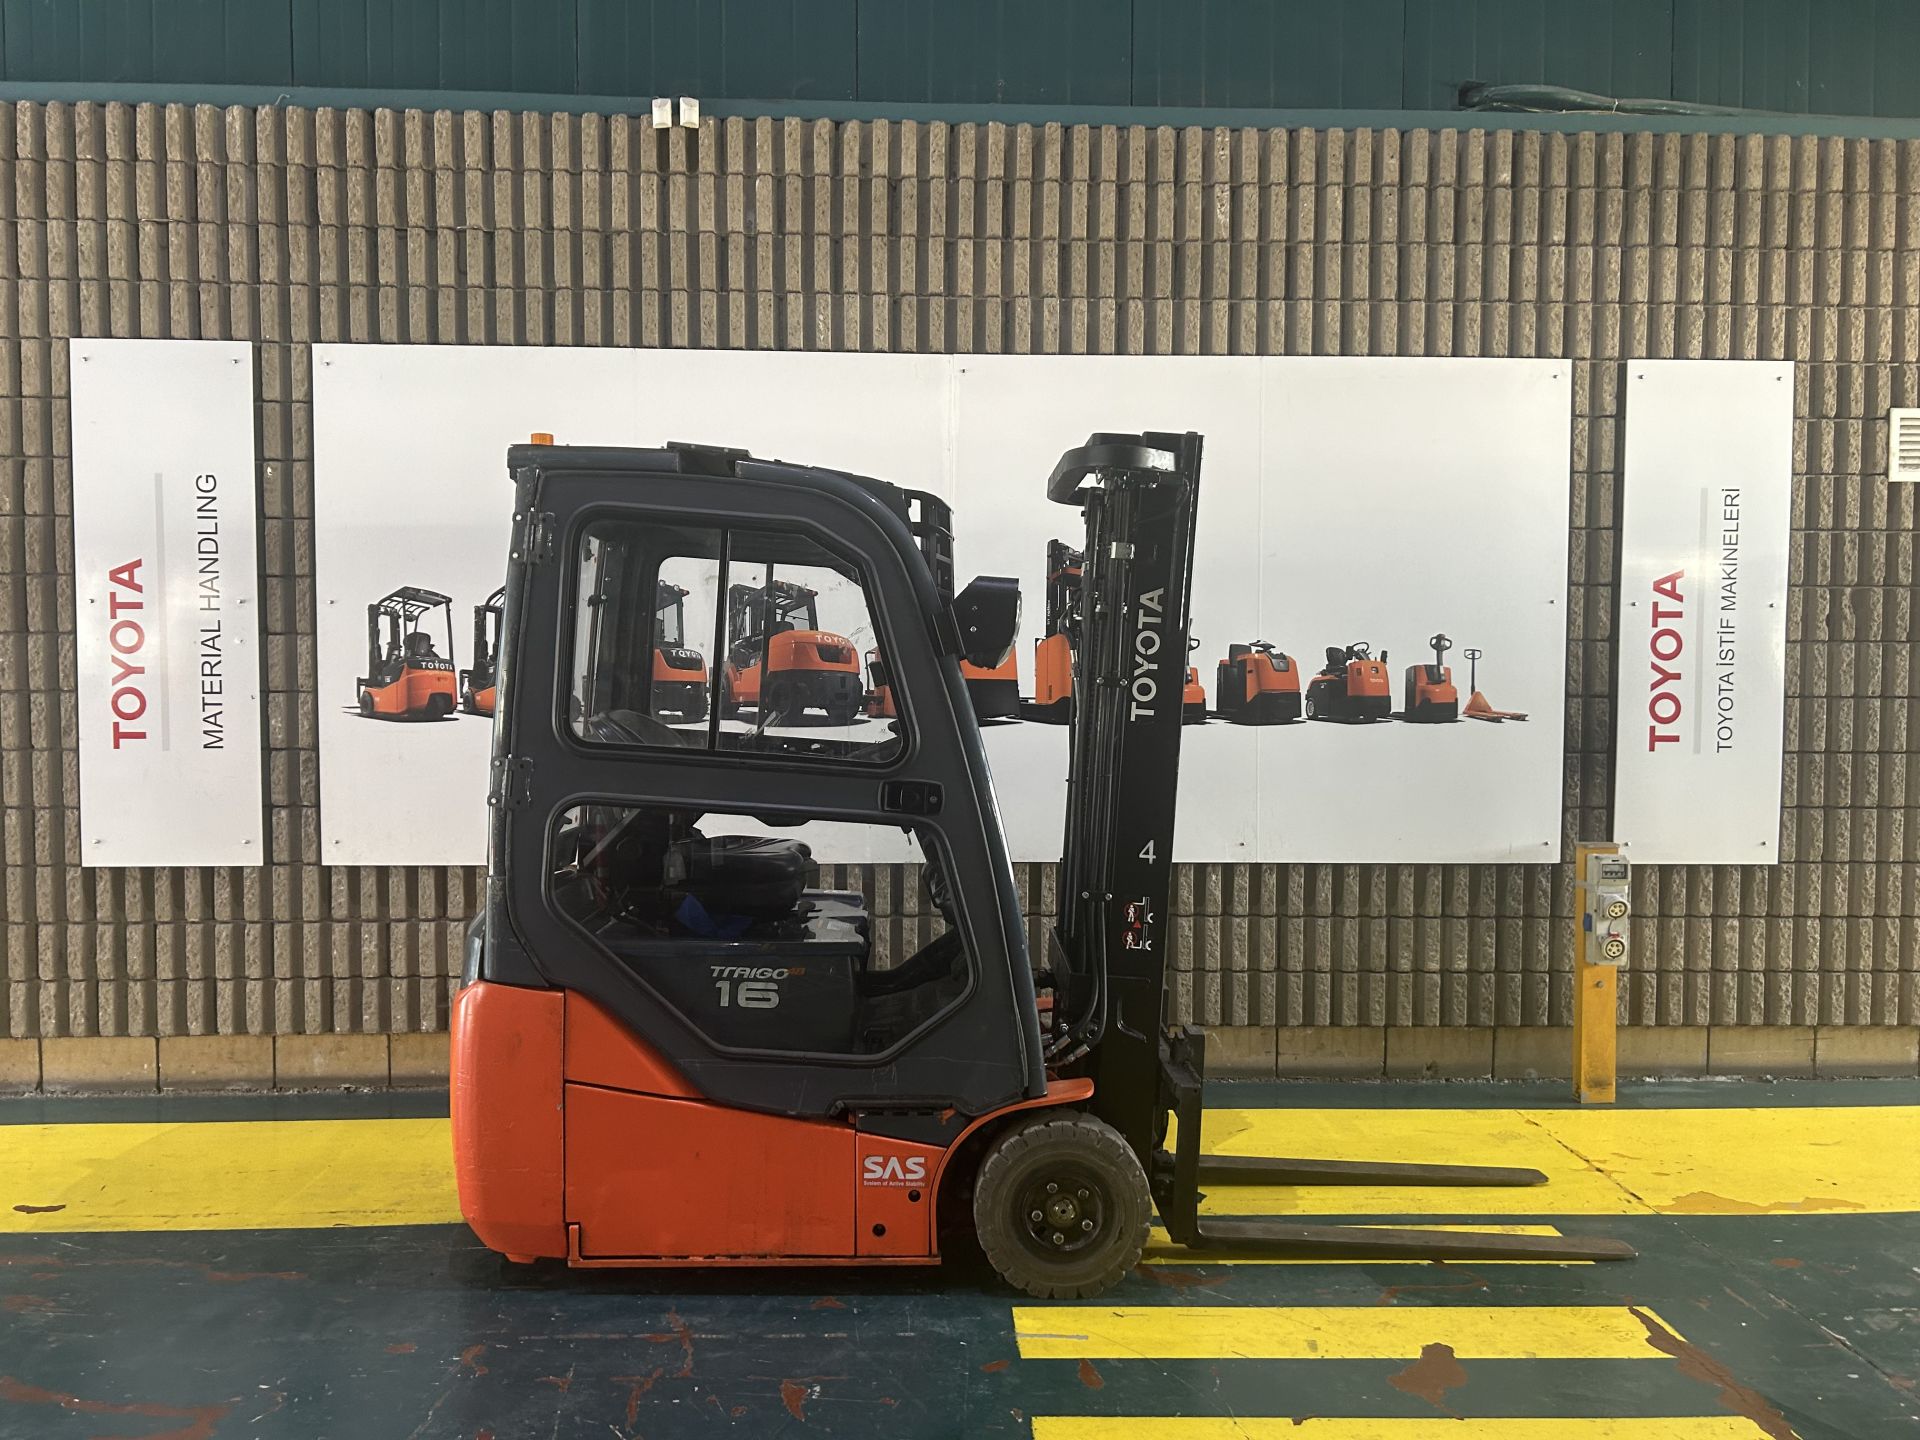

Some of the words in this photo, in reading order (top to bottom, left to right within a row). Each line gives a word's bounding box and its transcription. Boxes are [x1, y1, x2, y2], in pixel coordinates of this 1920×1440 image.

[196, 473, 221, 611] HANDLING
[1718, 488, 1740, 611] MAKİNELERİ
[109, 558, 147, 750] TOYOTA
[200, 619, 224, 749] MATERIAL
[420, 661, 454, 671] TOYOTA
[1130, 587, 1164, 722] TOYOTA
[1649, 569, 1685, 752] TOYOTA
[1716, 618, 1736, 667] İSTİF
[1717, 671, 1735, 753] TOYOTA
[1139, 839, 1156, 864] 4
[715, 980, 779, 1009] 16
[863, 1155, 926, 1180] SAS
